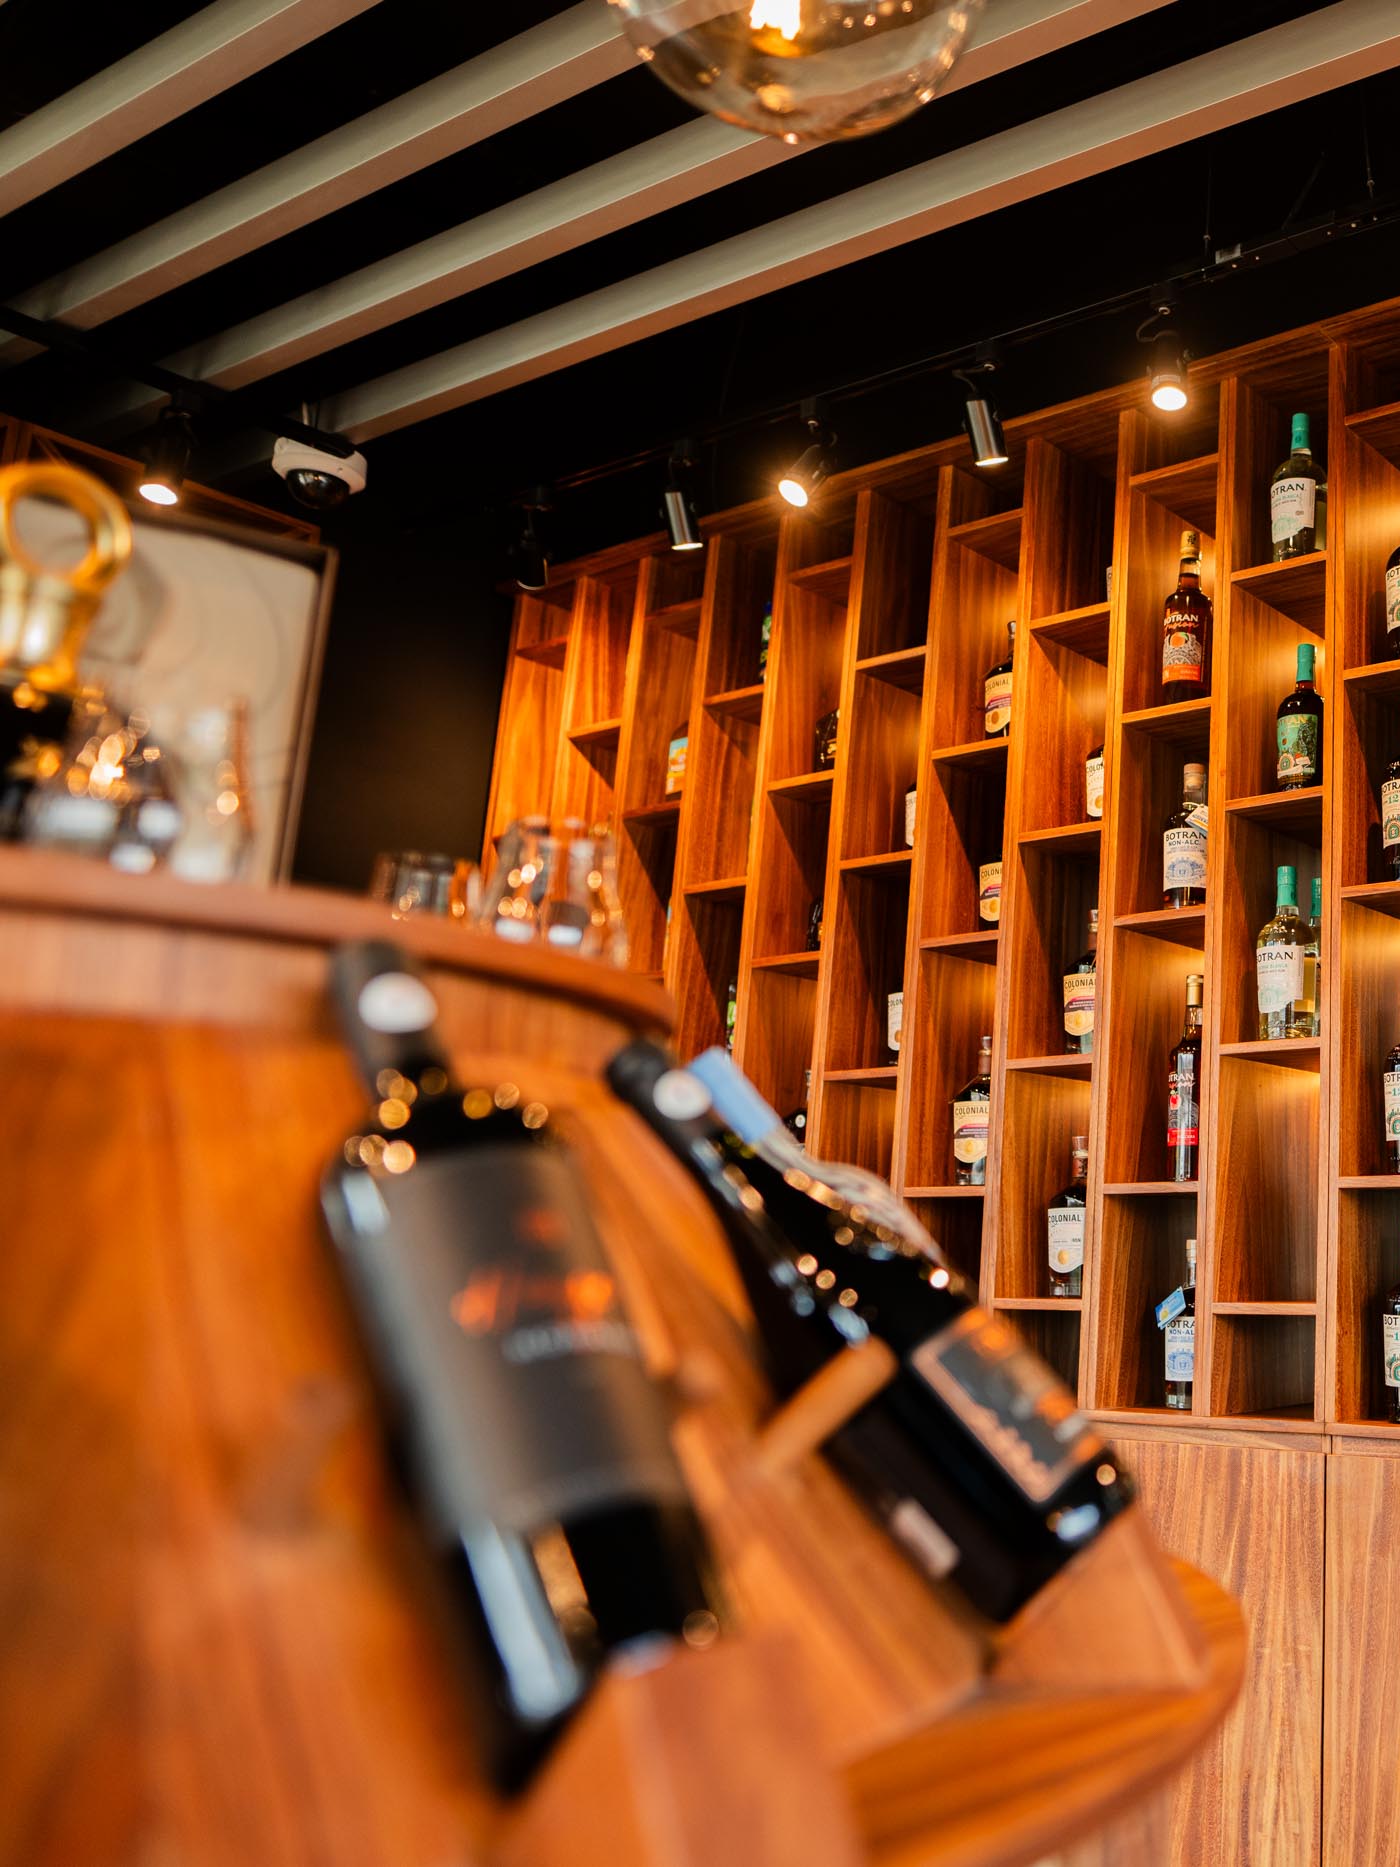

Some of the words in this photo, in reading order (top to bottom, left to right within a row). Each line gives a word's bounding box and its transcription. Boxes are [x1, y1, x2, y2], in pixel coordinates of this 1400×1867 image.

[1271, 483, 1305, 499] OTRAN
[1388, 793, 1400, 804] 12
[981, 868, 1002, 879] COLONI
[1168, 1072, 1195, 1083] TRAN
[955, 1106, 988, 1115] COLONIAL
[1049, 1214, 1081, 1223] COLONIAL
